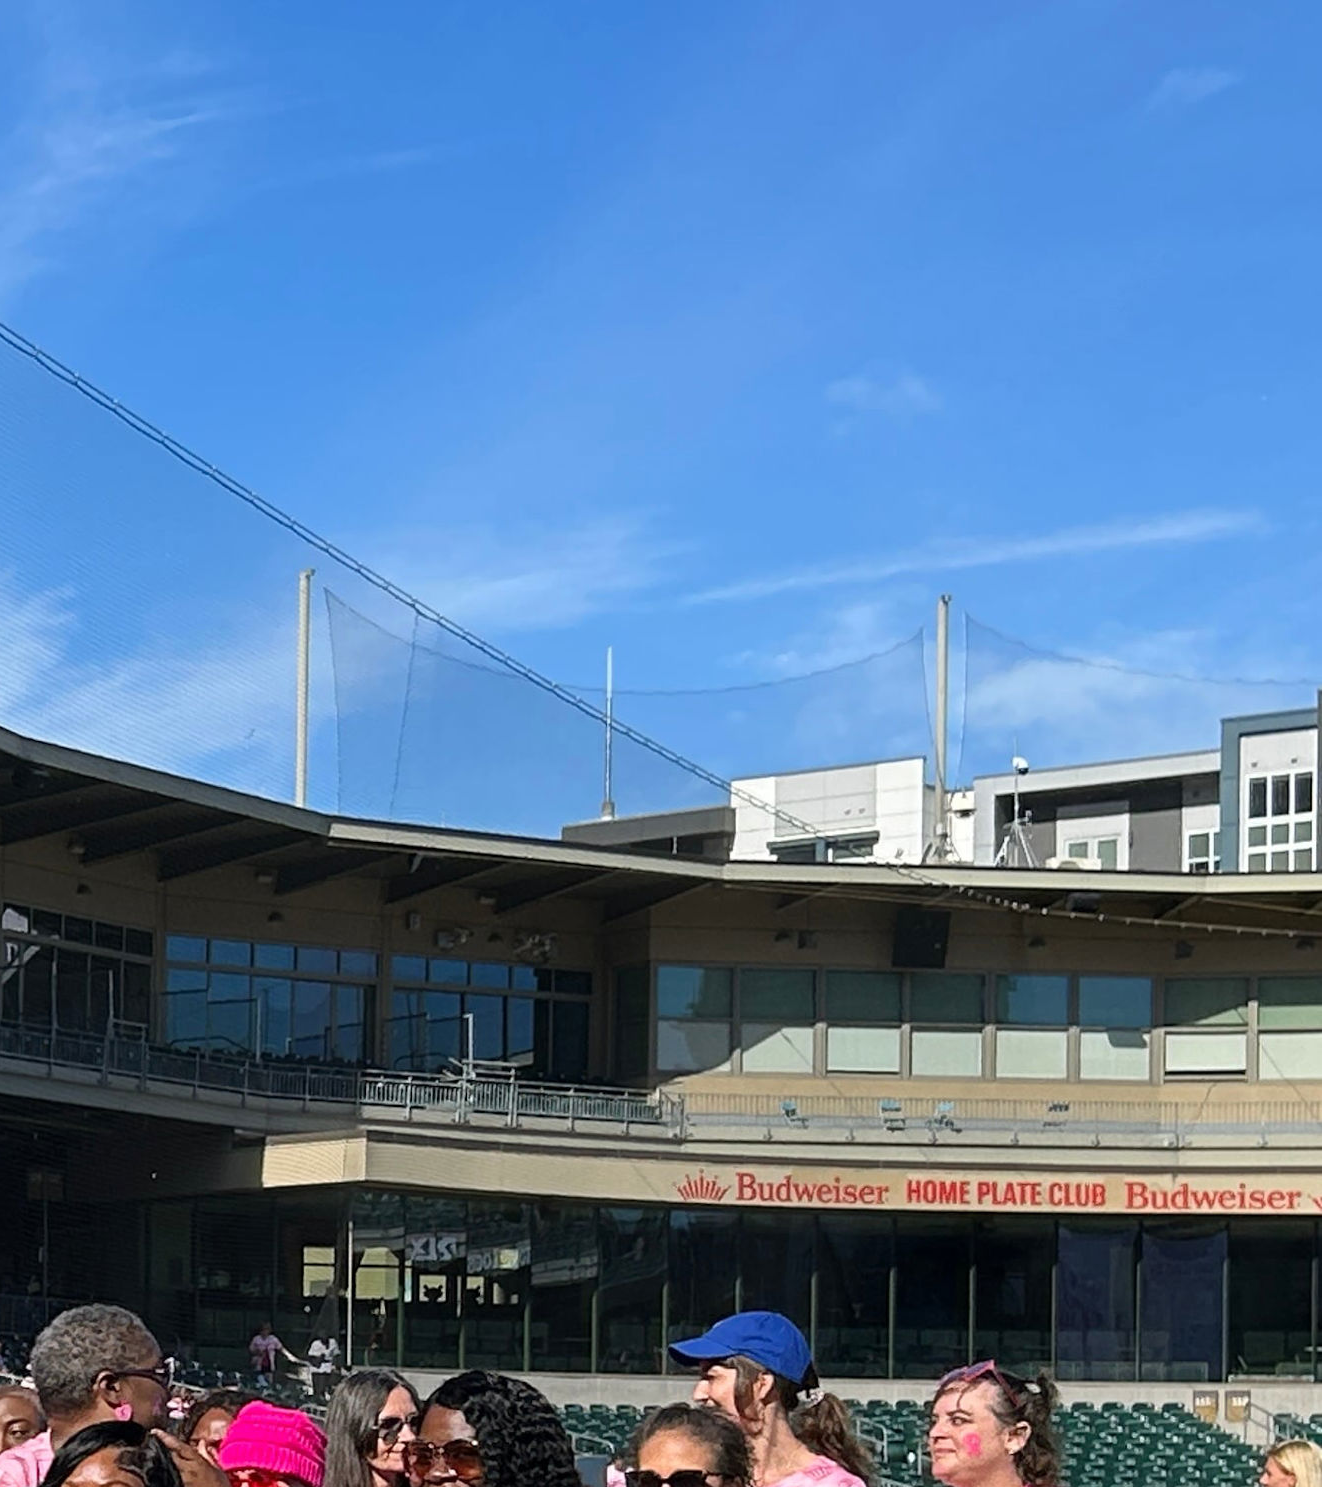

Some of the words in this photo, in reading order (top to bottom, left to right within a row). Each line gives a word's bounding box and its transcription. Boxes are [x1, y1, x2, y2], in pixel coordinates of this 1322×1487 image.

[735, 1172, 889, 1205] Budweiser
[907, 1180, 971, 1205] HOME
[977, 1181, 1042, 1206] PLATE
[1049, 1182, 1106, 1207] CLUB
[1124, 1181, 1302, 1210] Budweiser
